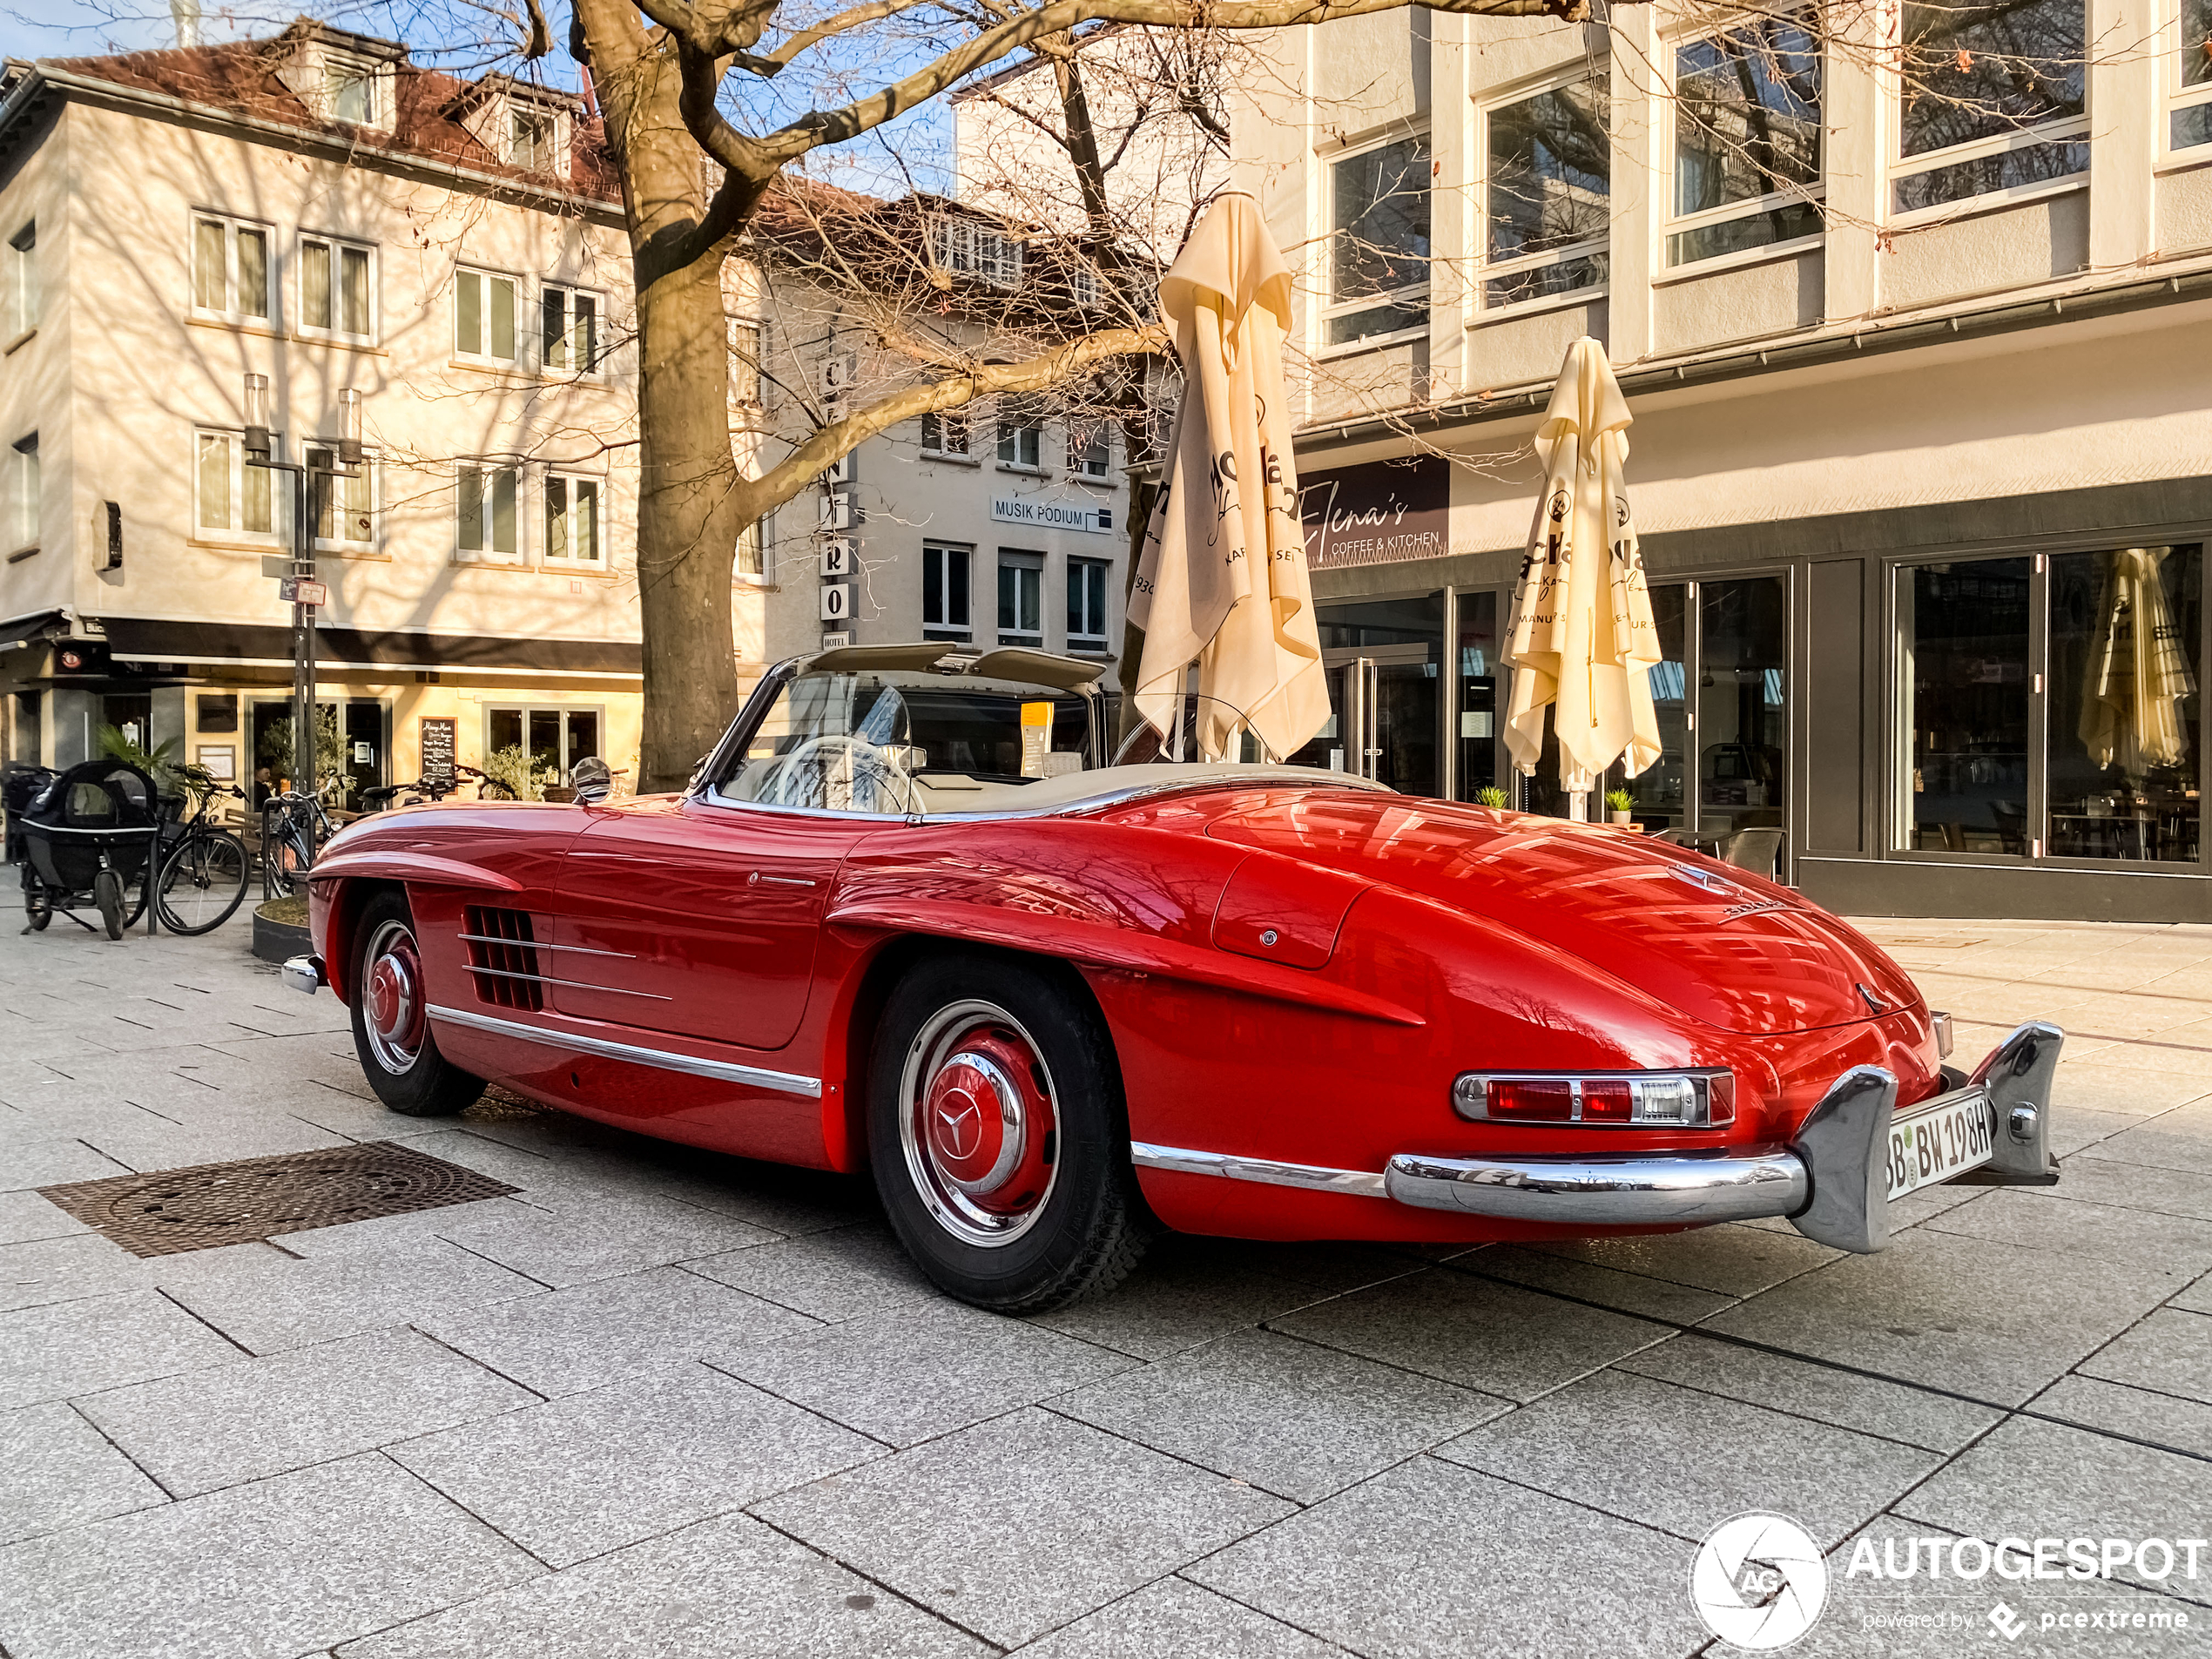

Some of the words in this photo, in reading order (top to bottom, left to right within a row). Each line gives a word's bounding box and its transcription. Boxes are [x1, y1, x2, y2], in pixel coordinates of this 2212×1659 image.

[995, 500, 1034, 519] MUSIK
[1037, 506, 1082, 525] PODIUM
[1297, 480, 1409, 563] Elena's
[1332, 538, 1373, 555] COFFEE
[1376, 539, 1385, 550] &
[1387, 531, 1440, 549] KITCHEN
[86, 623, 105, 632] Büc
[824, 637, 846, 647] HOTEL
[1916, 1119, 1944, 1178] BW
[1944, 1102, 1989, 1167] 198H
